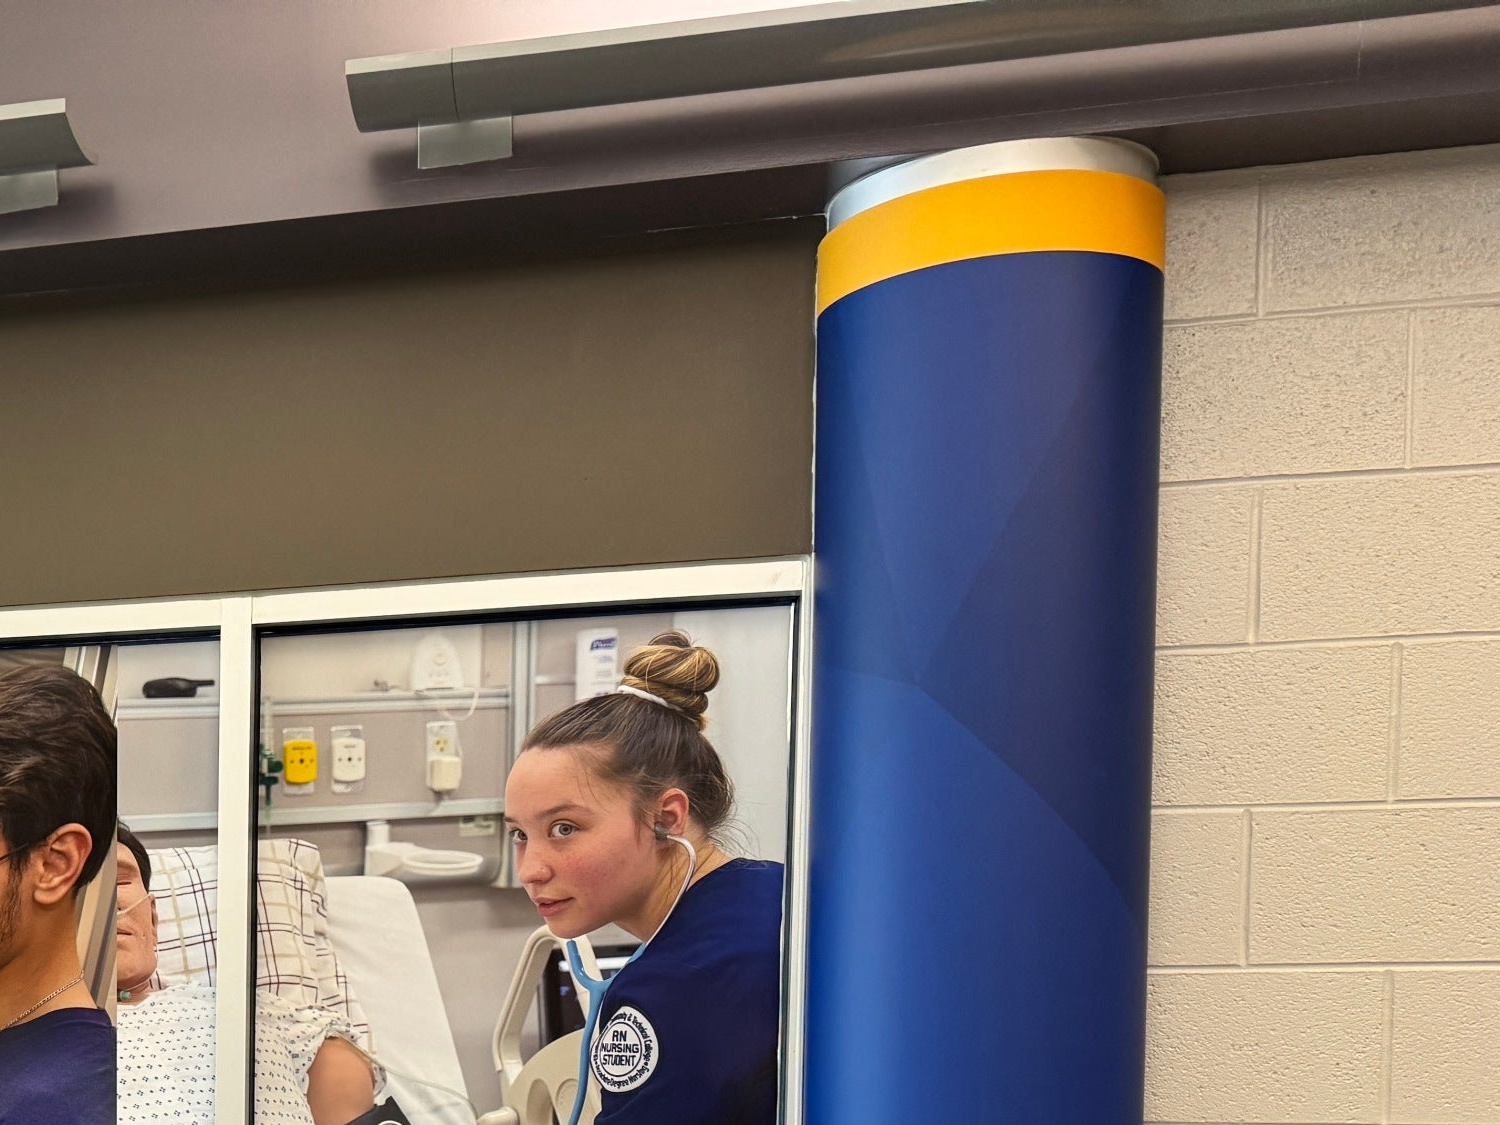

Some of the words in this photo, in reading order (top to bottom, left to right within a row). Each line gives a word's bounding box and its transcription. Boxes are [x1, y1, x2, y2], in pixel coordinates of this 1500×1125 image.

[612, 1030, 628, 1042] RN
[601, 1042, 639, 1054] NURSING
[602, 1053, 637, 1067] STUDENT
